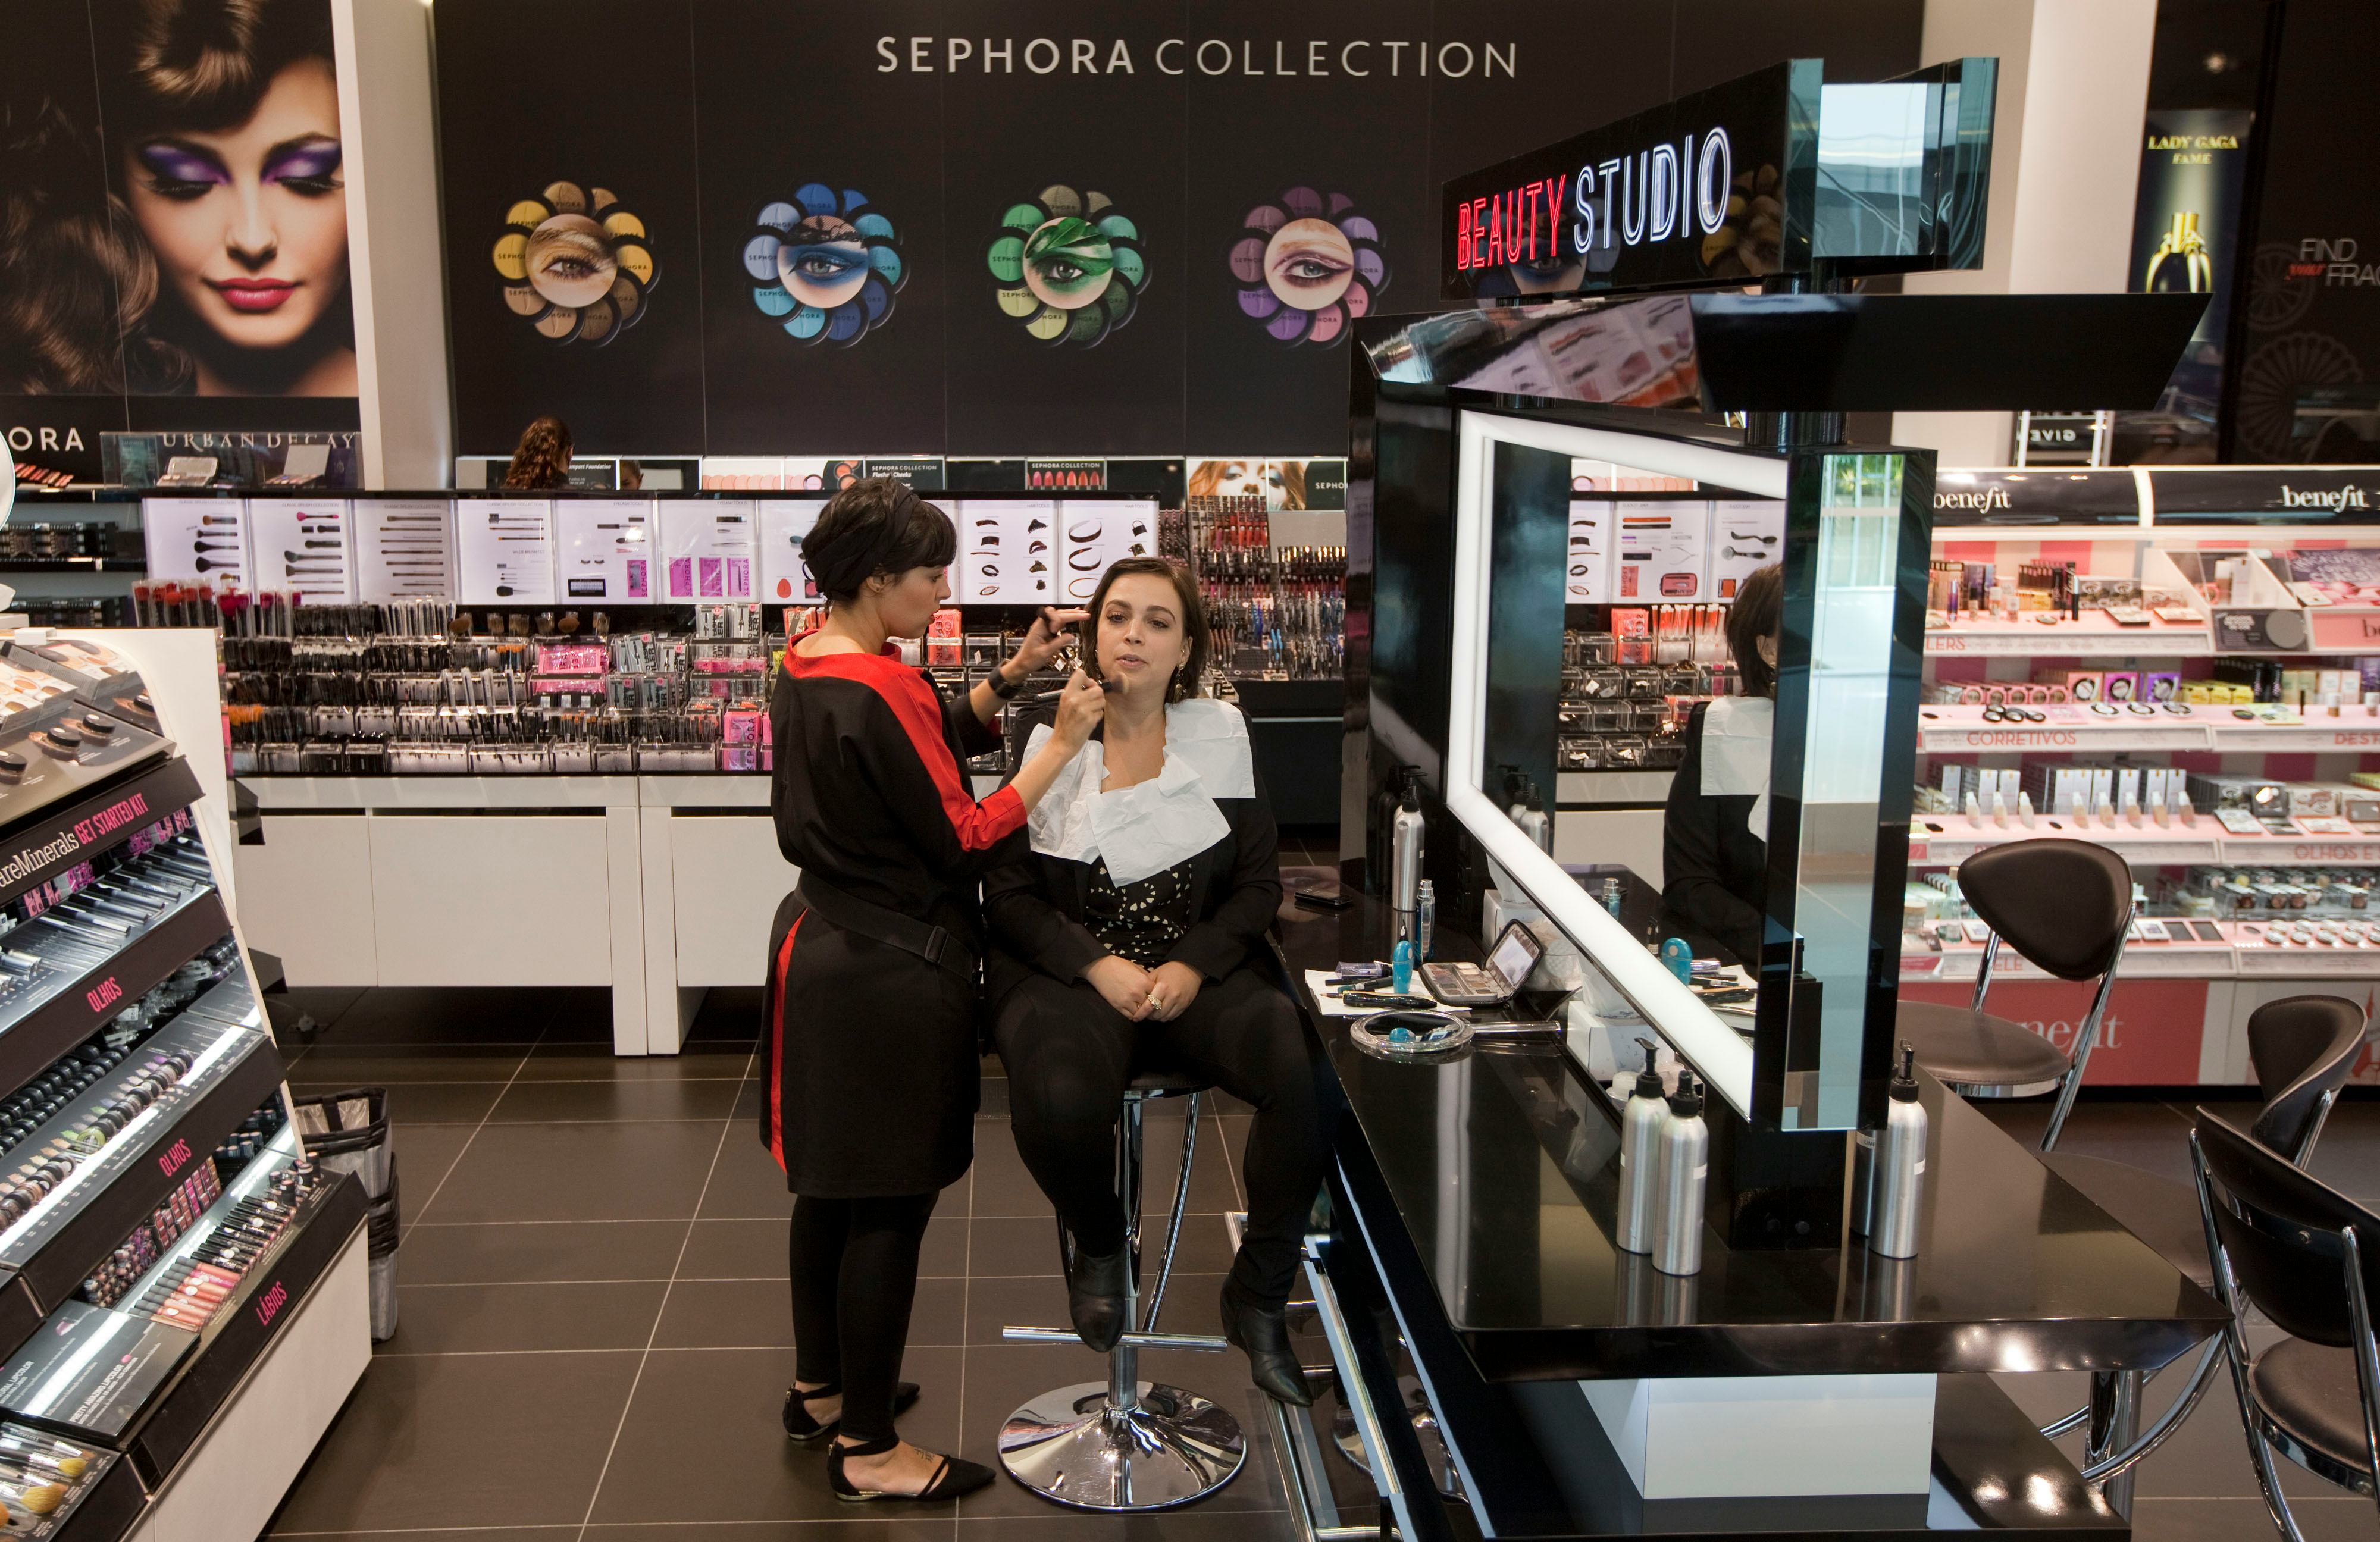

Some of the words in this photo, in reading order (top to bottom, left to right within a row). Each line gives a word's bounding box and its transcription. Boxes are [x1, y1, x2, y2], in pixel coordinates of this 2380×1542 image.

[876, 36, 1135, 74] SEPHORA
[1155, 39, 1517, 78] COLLECTION
[2148, 135, 2192, 149] LADY
[2194, 135, 2238, 149] GAGA
[2172, 152, 2212, 164] FAME
[1458, 174, 1567, 271] BEAUTY
[1574, 126, 1731, 254] STUDIO
[2299, 238, 2358, 262] FIND
[163, 432, 254, 452] URBAN
[1934, 486, 2012, 515] benefit
[2280, 484, 2371, 513] benefit
[747, 717, 756, 771] SEPORA
[1967, 731, 2077, 746] CORRETIVOS
[74, 819, 98, 845] GET
[92, 800, 135, 835] STARTED
[129, 792, 149, 816] KIT
[2294, 844, 2358, 860] OLHOS
[2363, 845, 2373, 860] E
[1994, 956, 2022, 971] ELE
[86, 976, 123, 1013] OLHOS
[159, 1138, 192, 1177] OLHOS
[255, 1281, 287, 1327] LÁBIOS
[69, 1403, 90, 1422] PRETTY
[102, 1364, 125, 1386] LIPCOLOR
